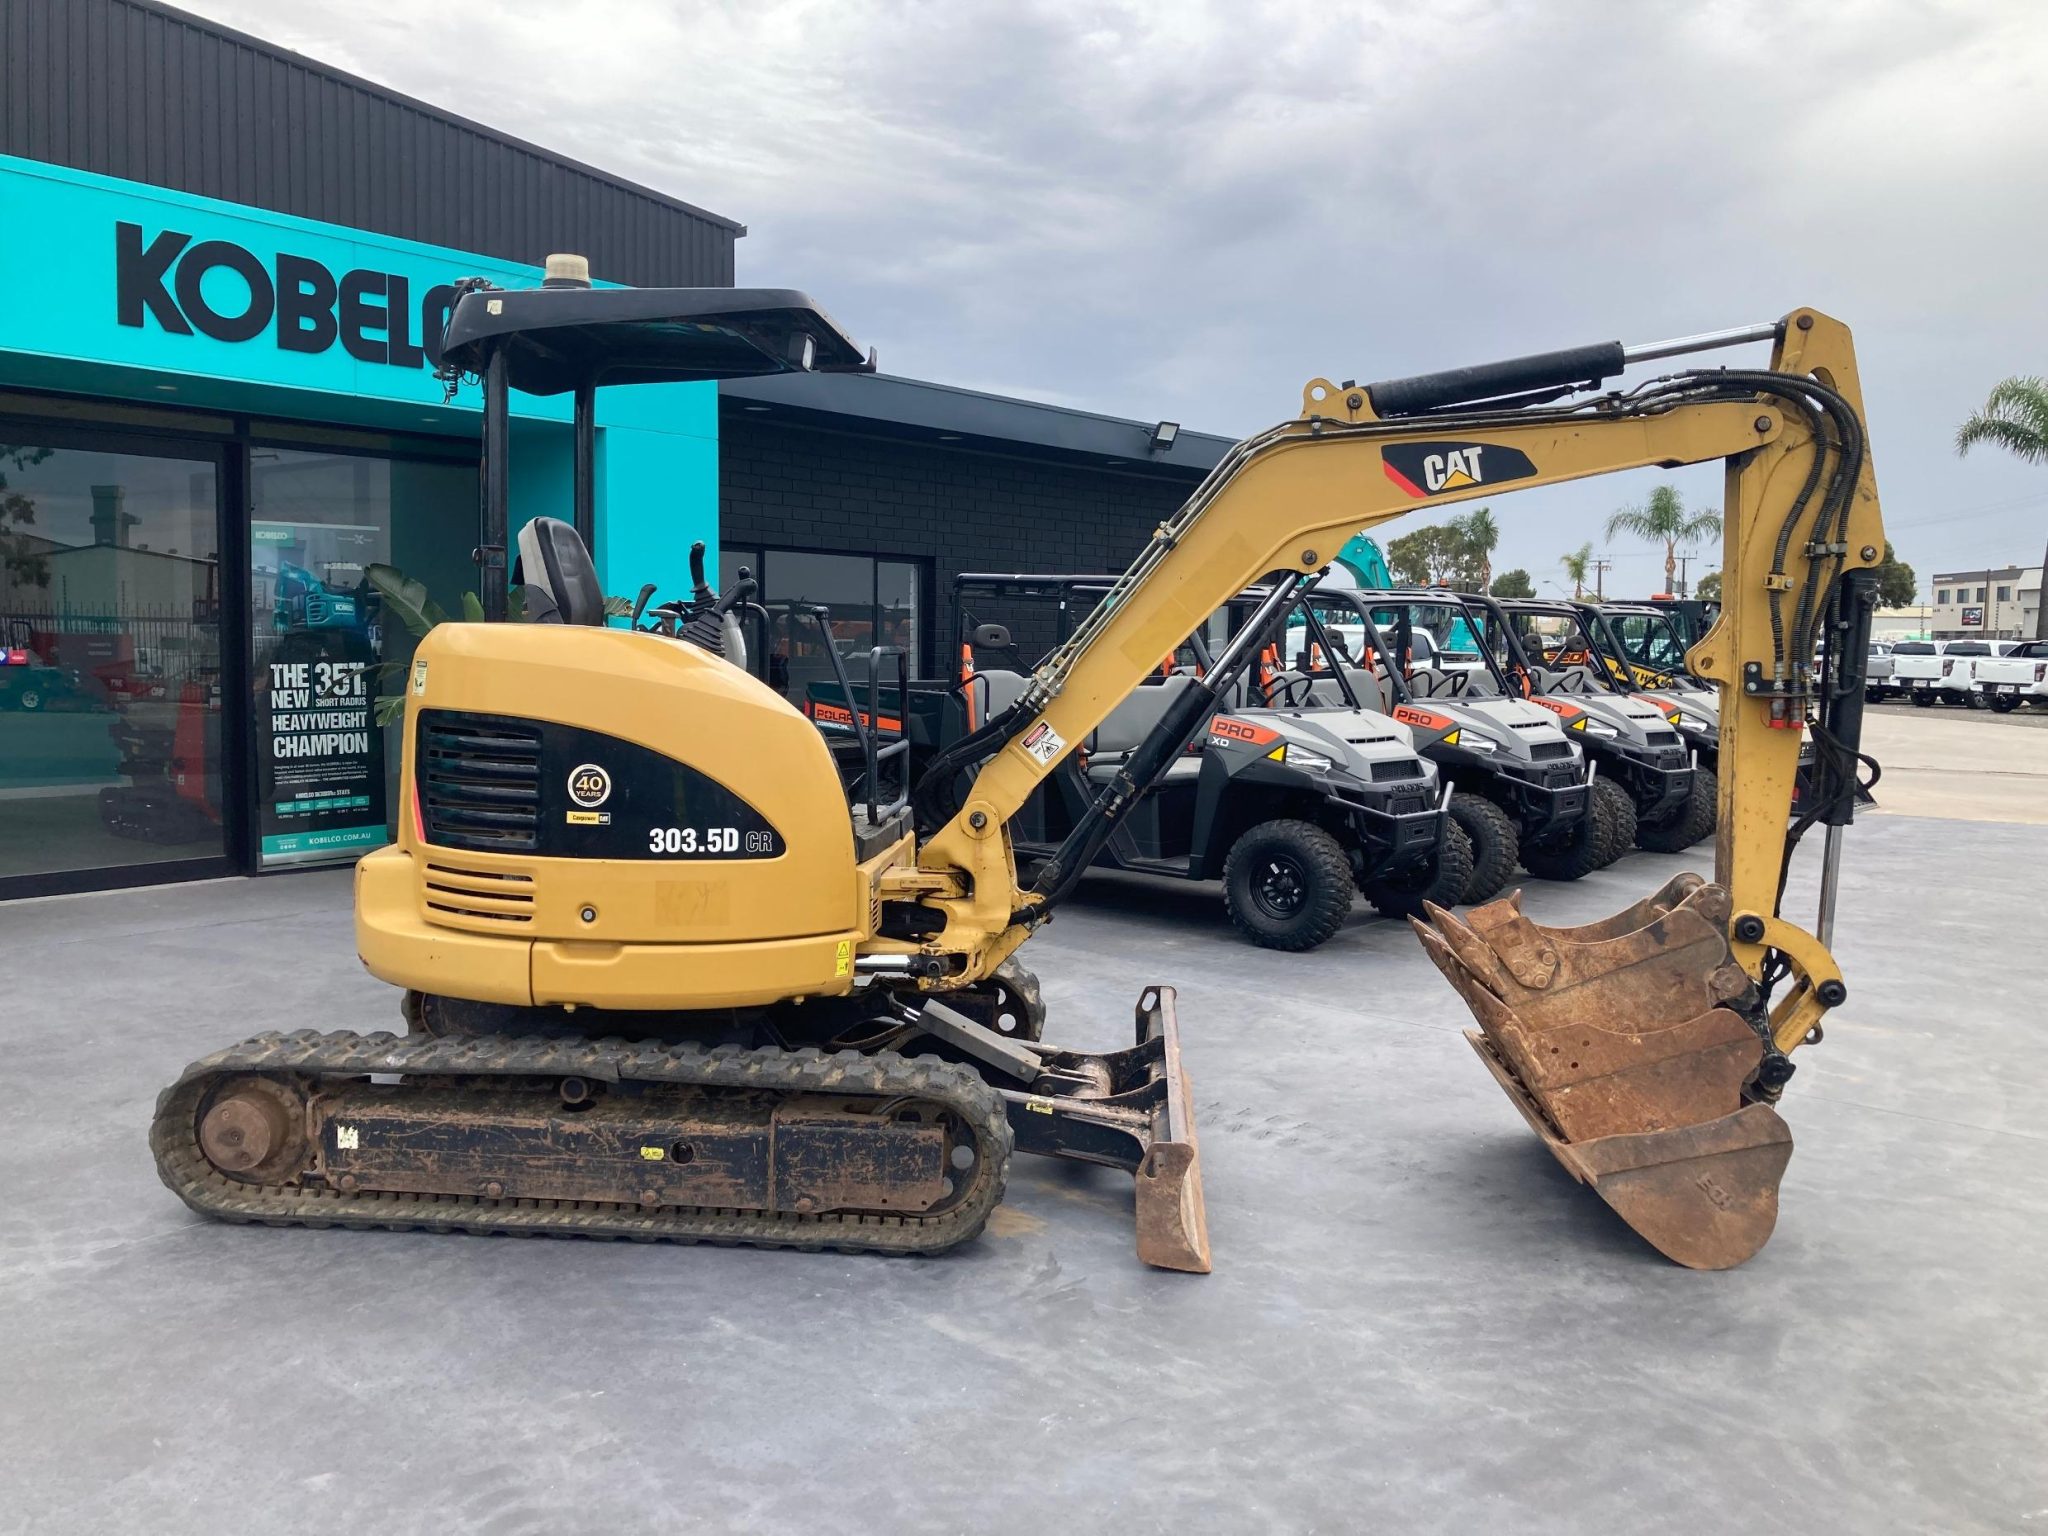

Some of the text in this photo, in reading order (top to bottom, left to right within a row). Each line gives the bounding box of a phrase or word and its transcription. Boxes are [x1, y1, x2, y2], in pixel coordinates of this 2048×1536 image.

[1423, 446, 1482, 491] CAT
[270, 663, 310, 688] THE
[314, 662, 365, 696] 35T
[271, 689, 309, 709] NEW
[315, 696, 367, 707] SHORT RADIUS
[272, 711, 367, 732] HEAVYWEIGHT
[816, 709, 865, 724] POLARS
[1396, 709, 1432, 726] PRO
[1214, 721, 1255, 740] PRO
[273, 732, 369, 758] CHAMPION
[1211, 736, 1230, 747] XD
[575, 776, 603, 791] 40
[575, 790, 602, 798] YEARS
[648, 827, 773, 853] 303.5D CR
